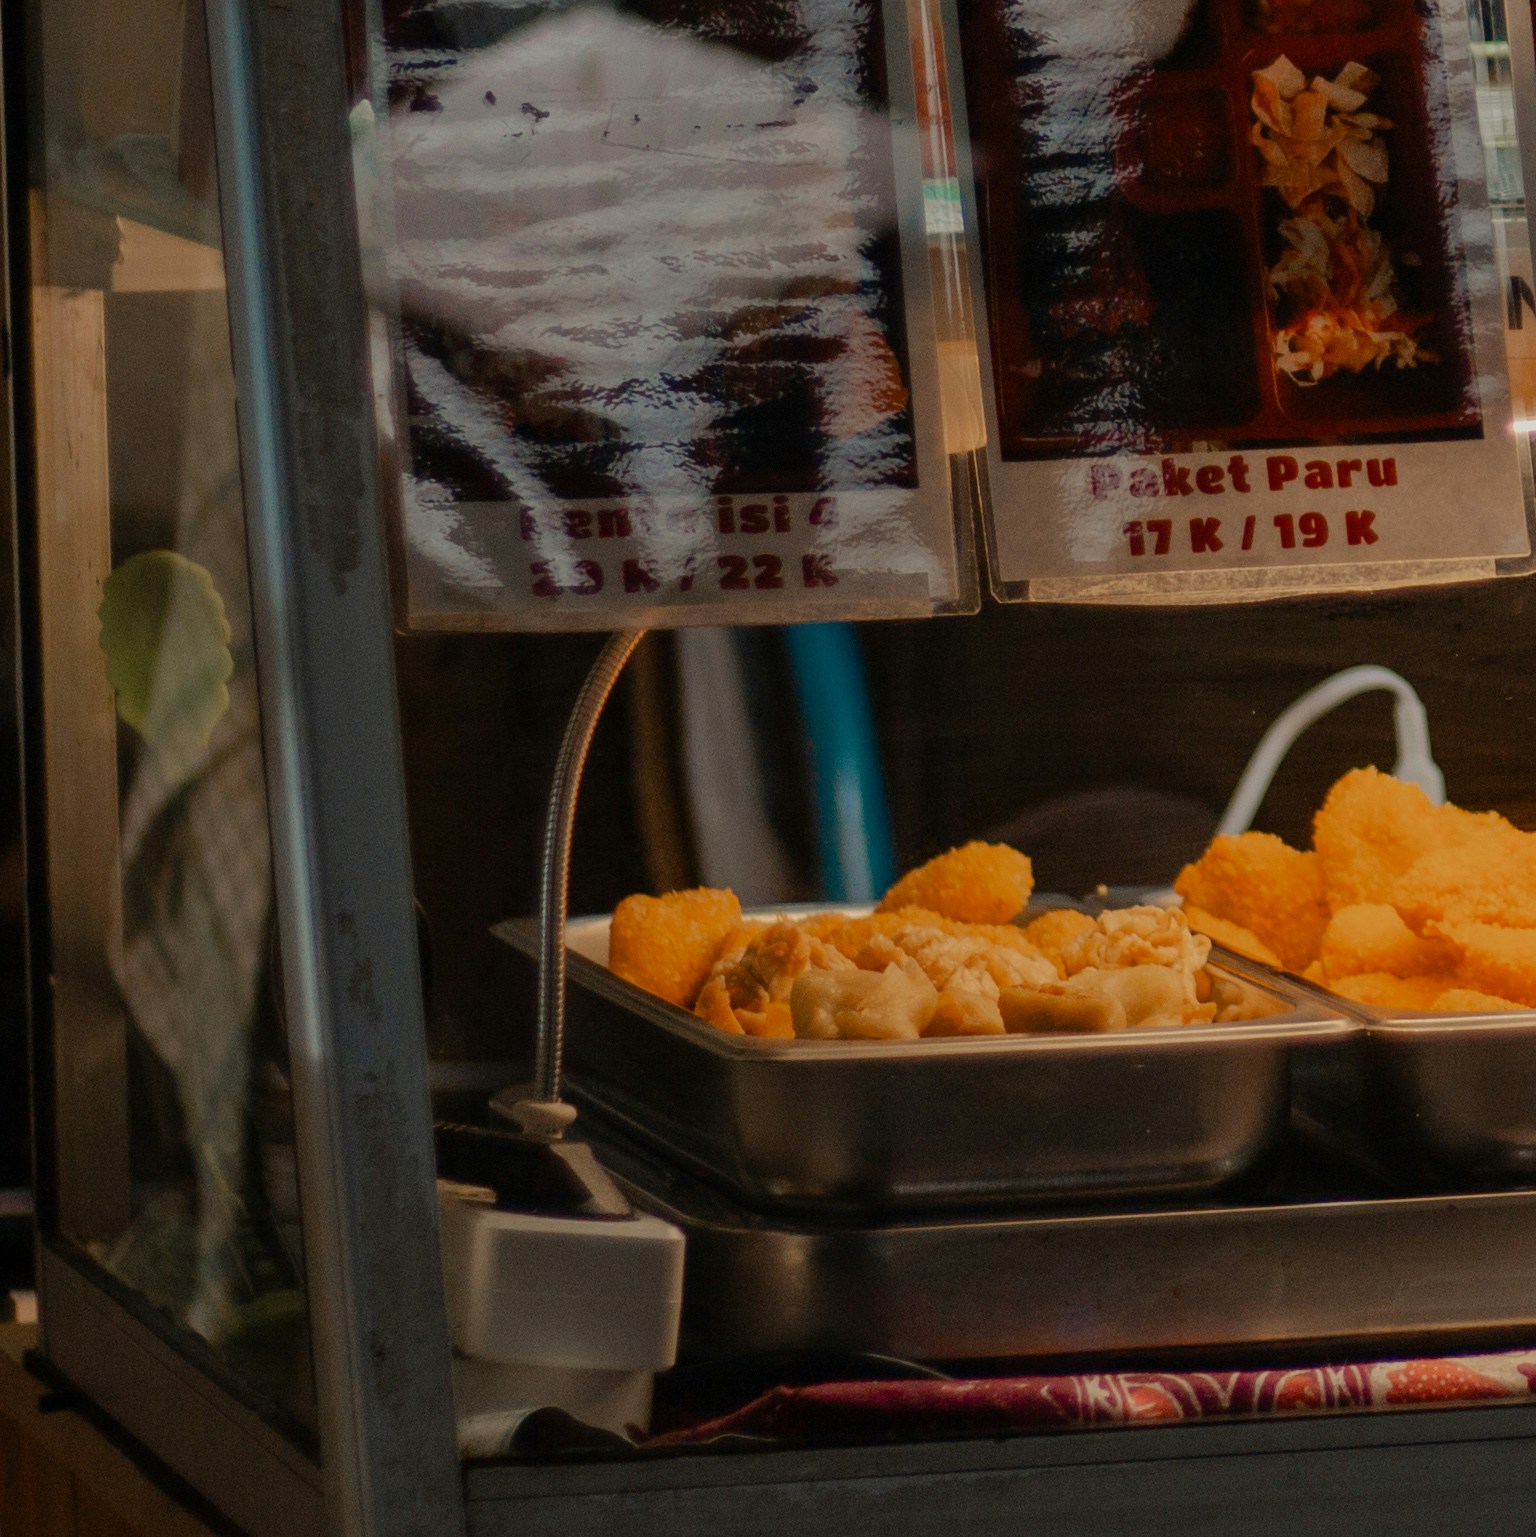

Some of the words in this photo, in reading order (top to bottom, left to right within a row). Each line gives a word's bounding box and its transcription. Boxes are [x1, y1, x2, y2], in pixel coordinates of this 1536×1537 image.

[1089, 454, 1251, 499] Paket
[1265, 455, 1398, 492] Paru
[717, 495, 791, 534] isi
[1125, 519, 1172, 557] 17
[1189, 517, 1223, 554] K
[1241, 515, 1256, 551] /
[1273, 512, 1329, 549] 19
[1344, 510, 1378, 546] K
[717, 553, 784, 590] 22
[799, 553, 839, 590] K
